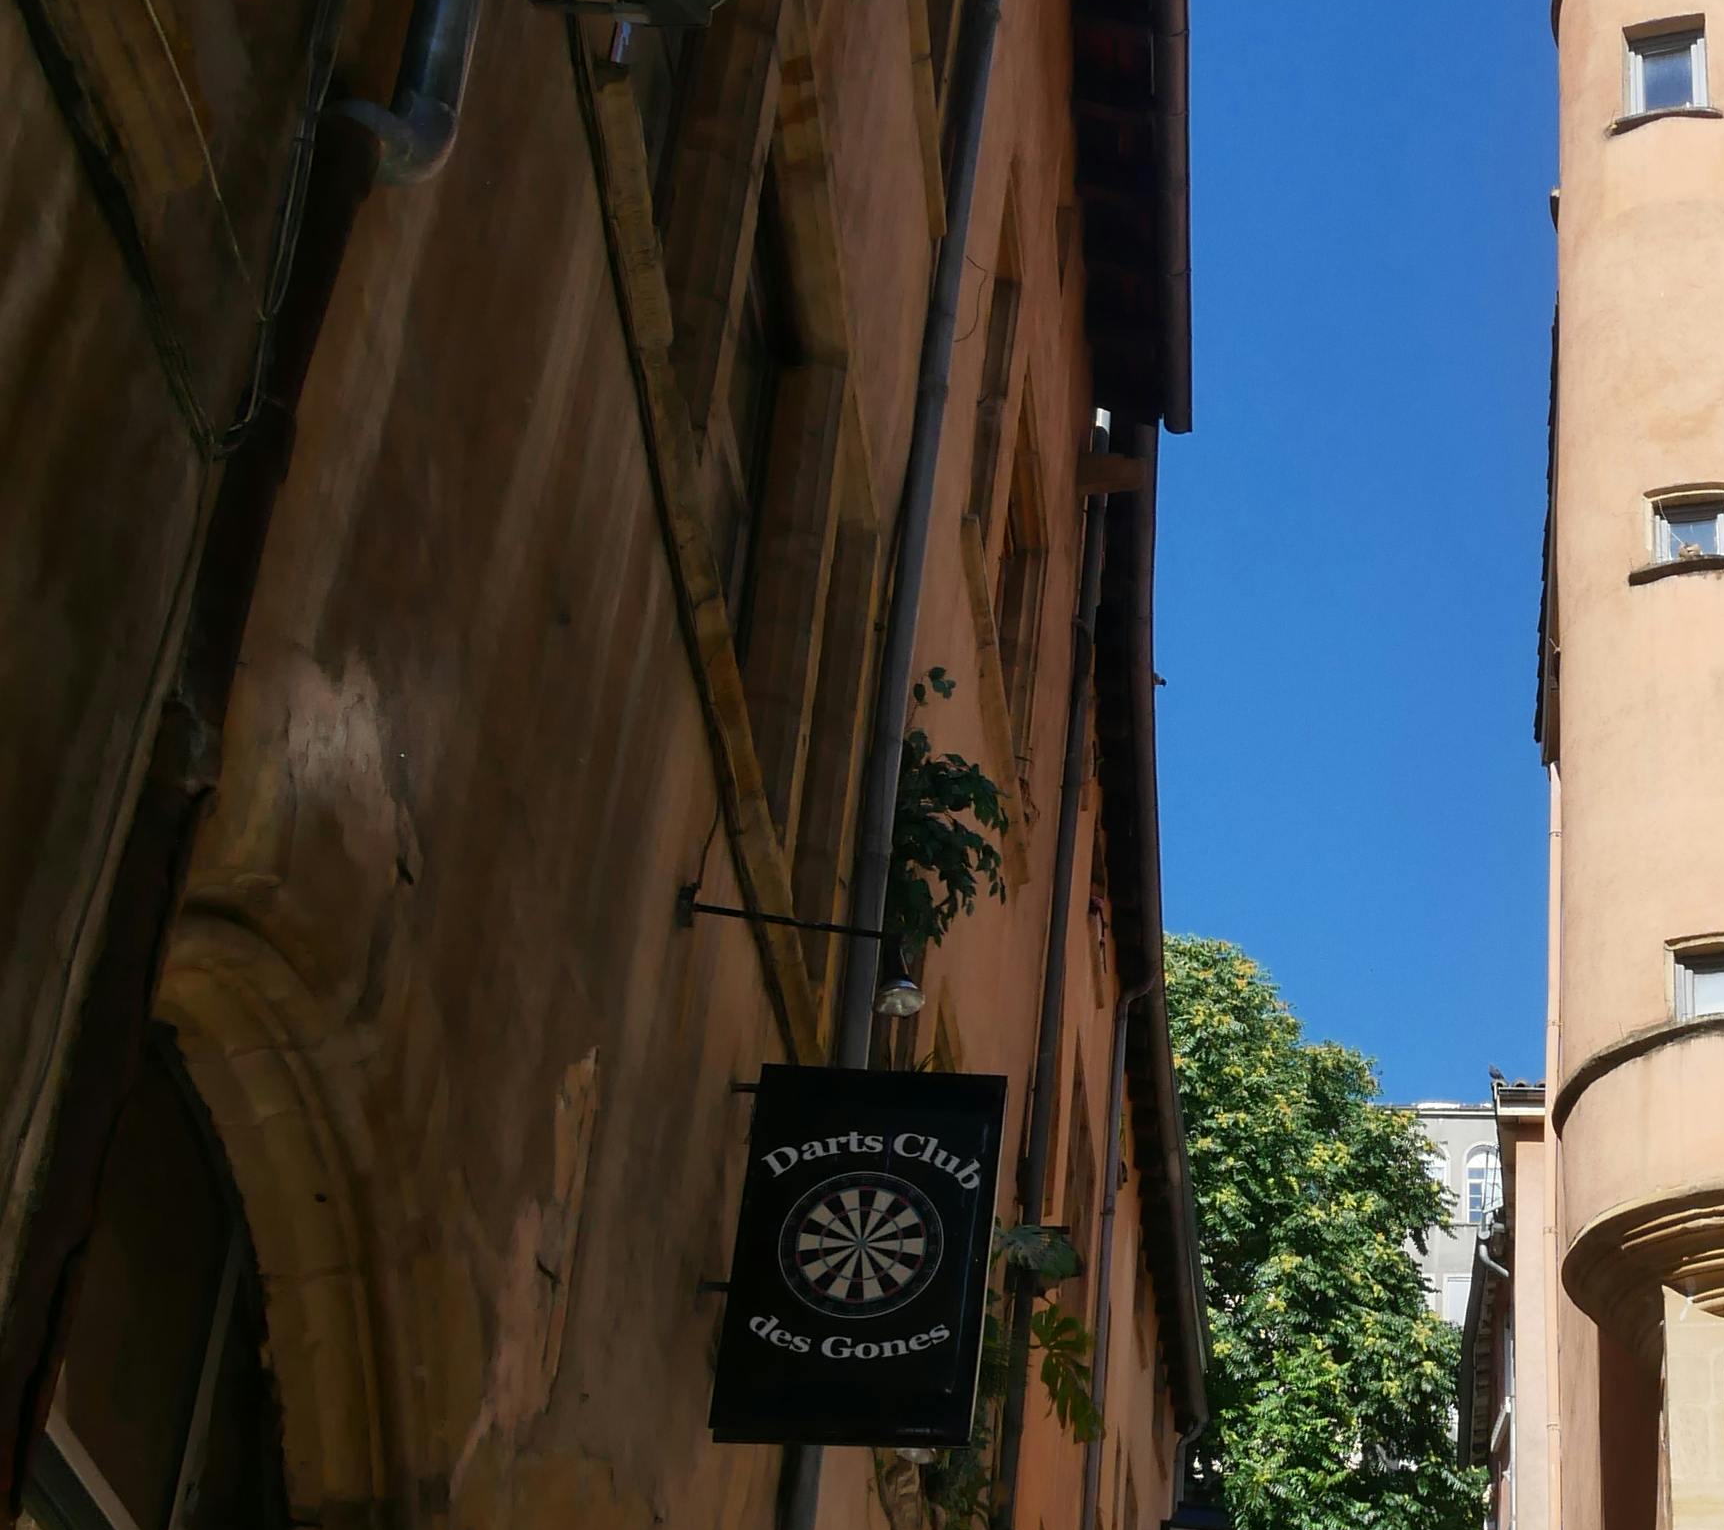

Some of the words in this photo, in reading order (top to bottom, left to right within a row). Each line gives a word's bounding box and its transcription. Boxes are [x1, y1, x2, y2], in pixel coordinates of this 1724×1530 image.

[761, 1130, 884, 1178] Darts
[893, 1131, 981, 1190] Club
[748, 1314, 811, 1353] des
[820, 1323, 950, 1360] Gones
